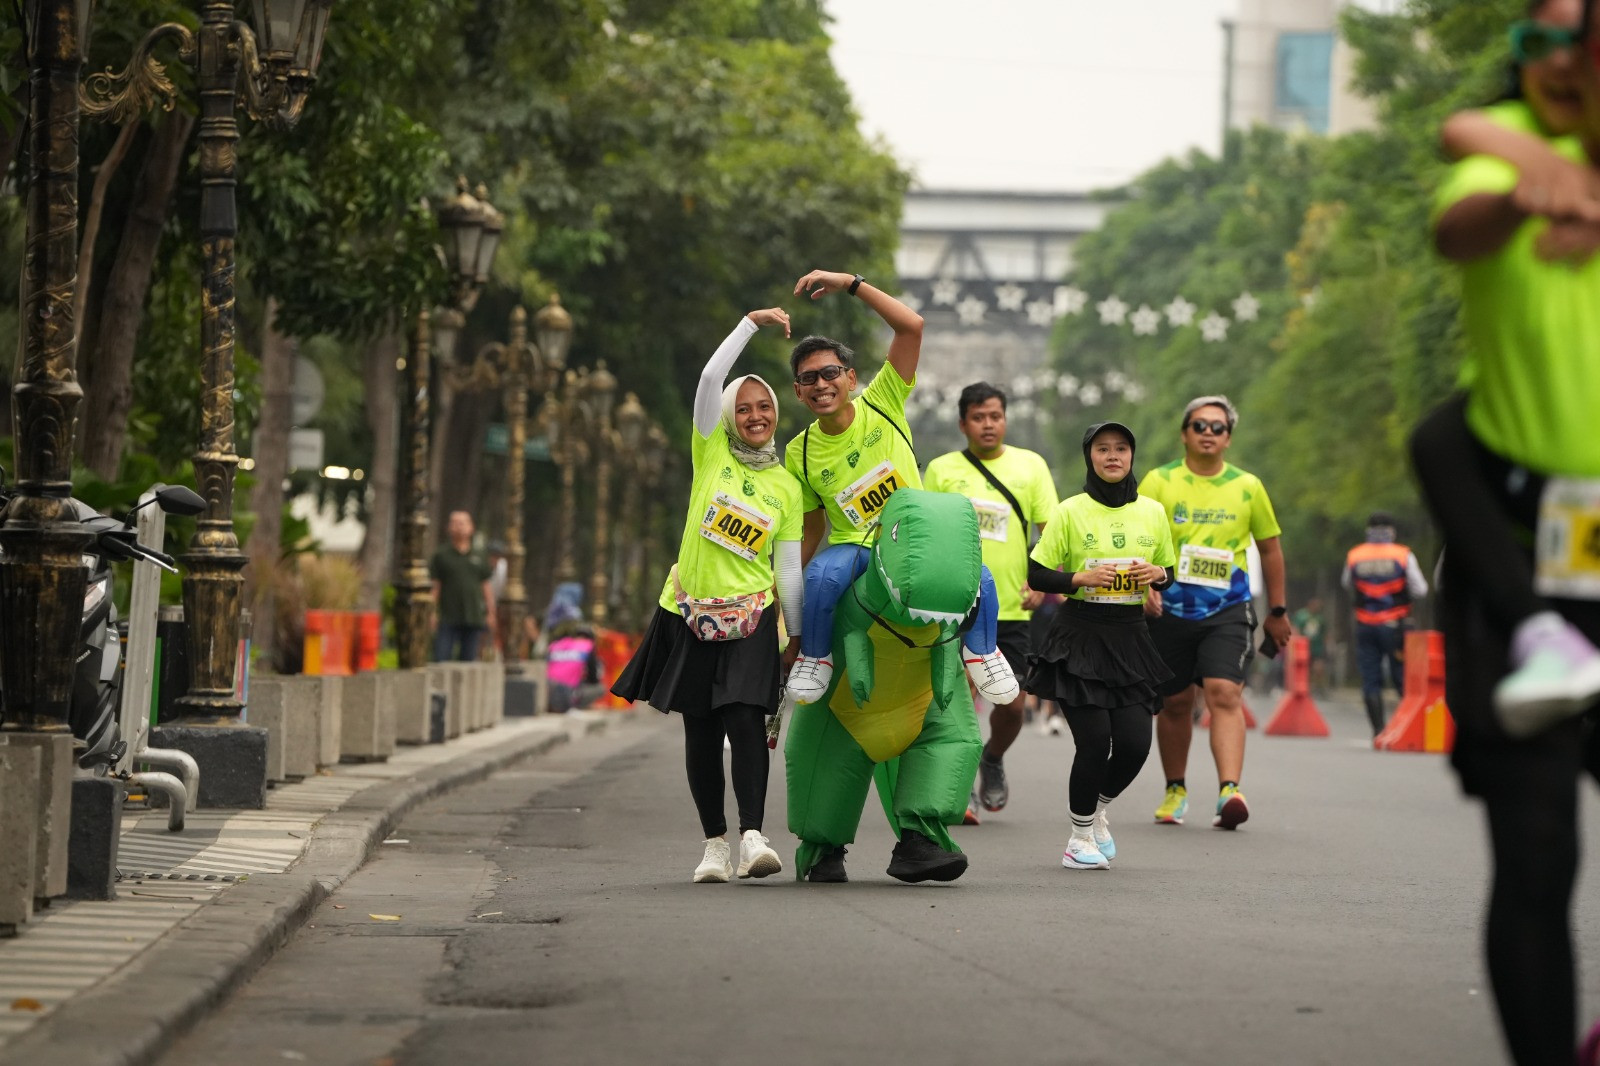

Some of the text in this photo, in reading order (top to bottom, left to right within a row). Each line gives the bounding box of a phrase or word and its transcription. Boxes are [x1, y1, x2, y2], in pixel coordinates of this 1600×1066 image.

[859, 475, 898, 514] 4047
[717, 513, 763, 547] 4047
[1192, 558, 1227, 578] 52115
